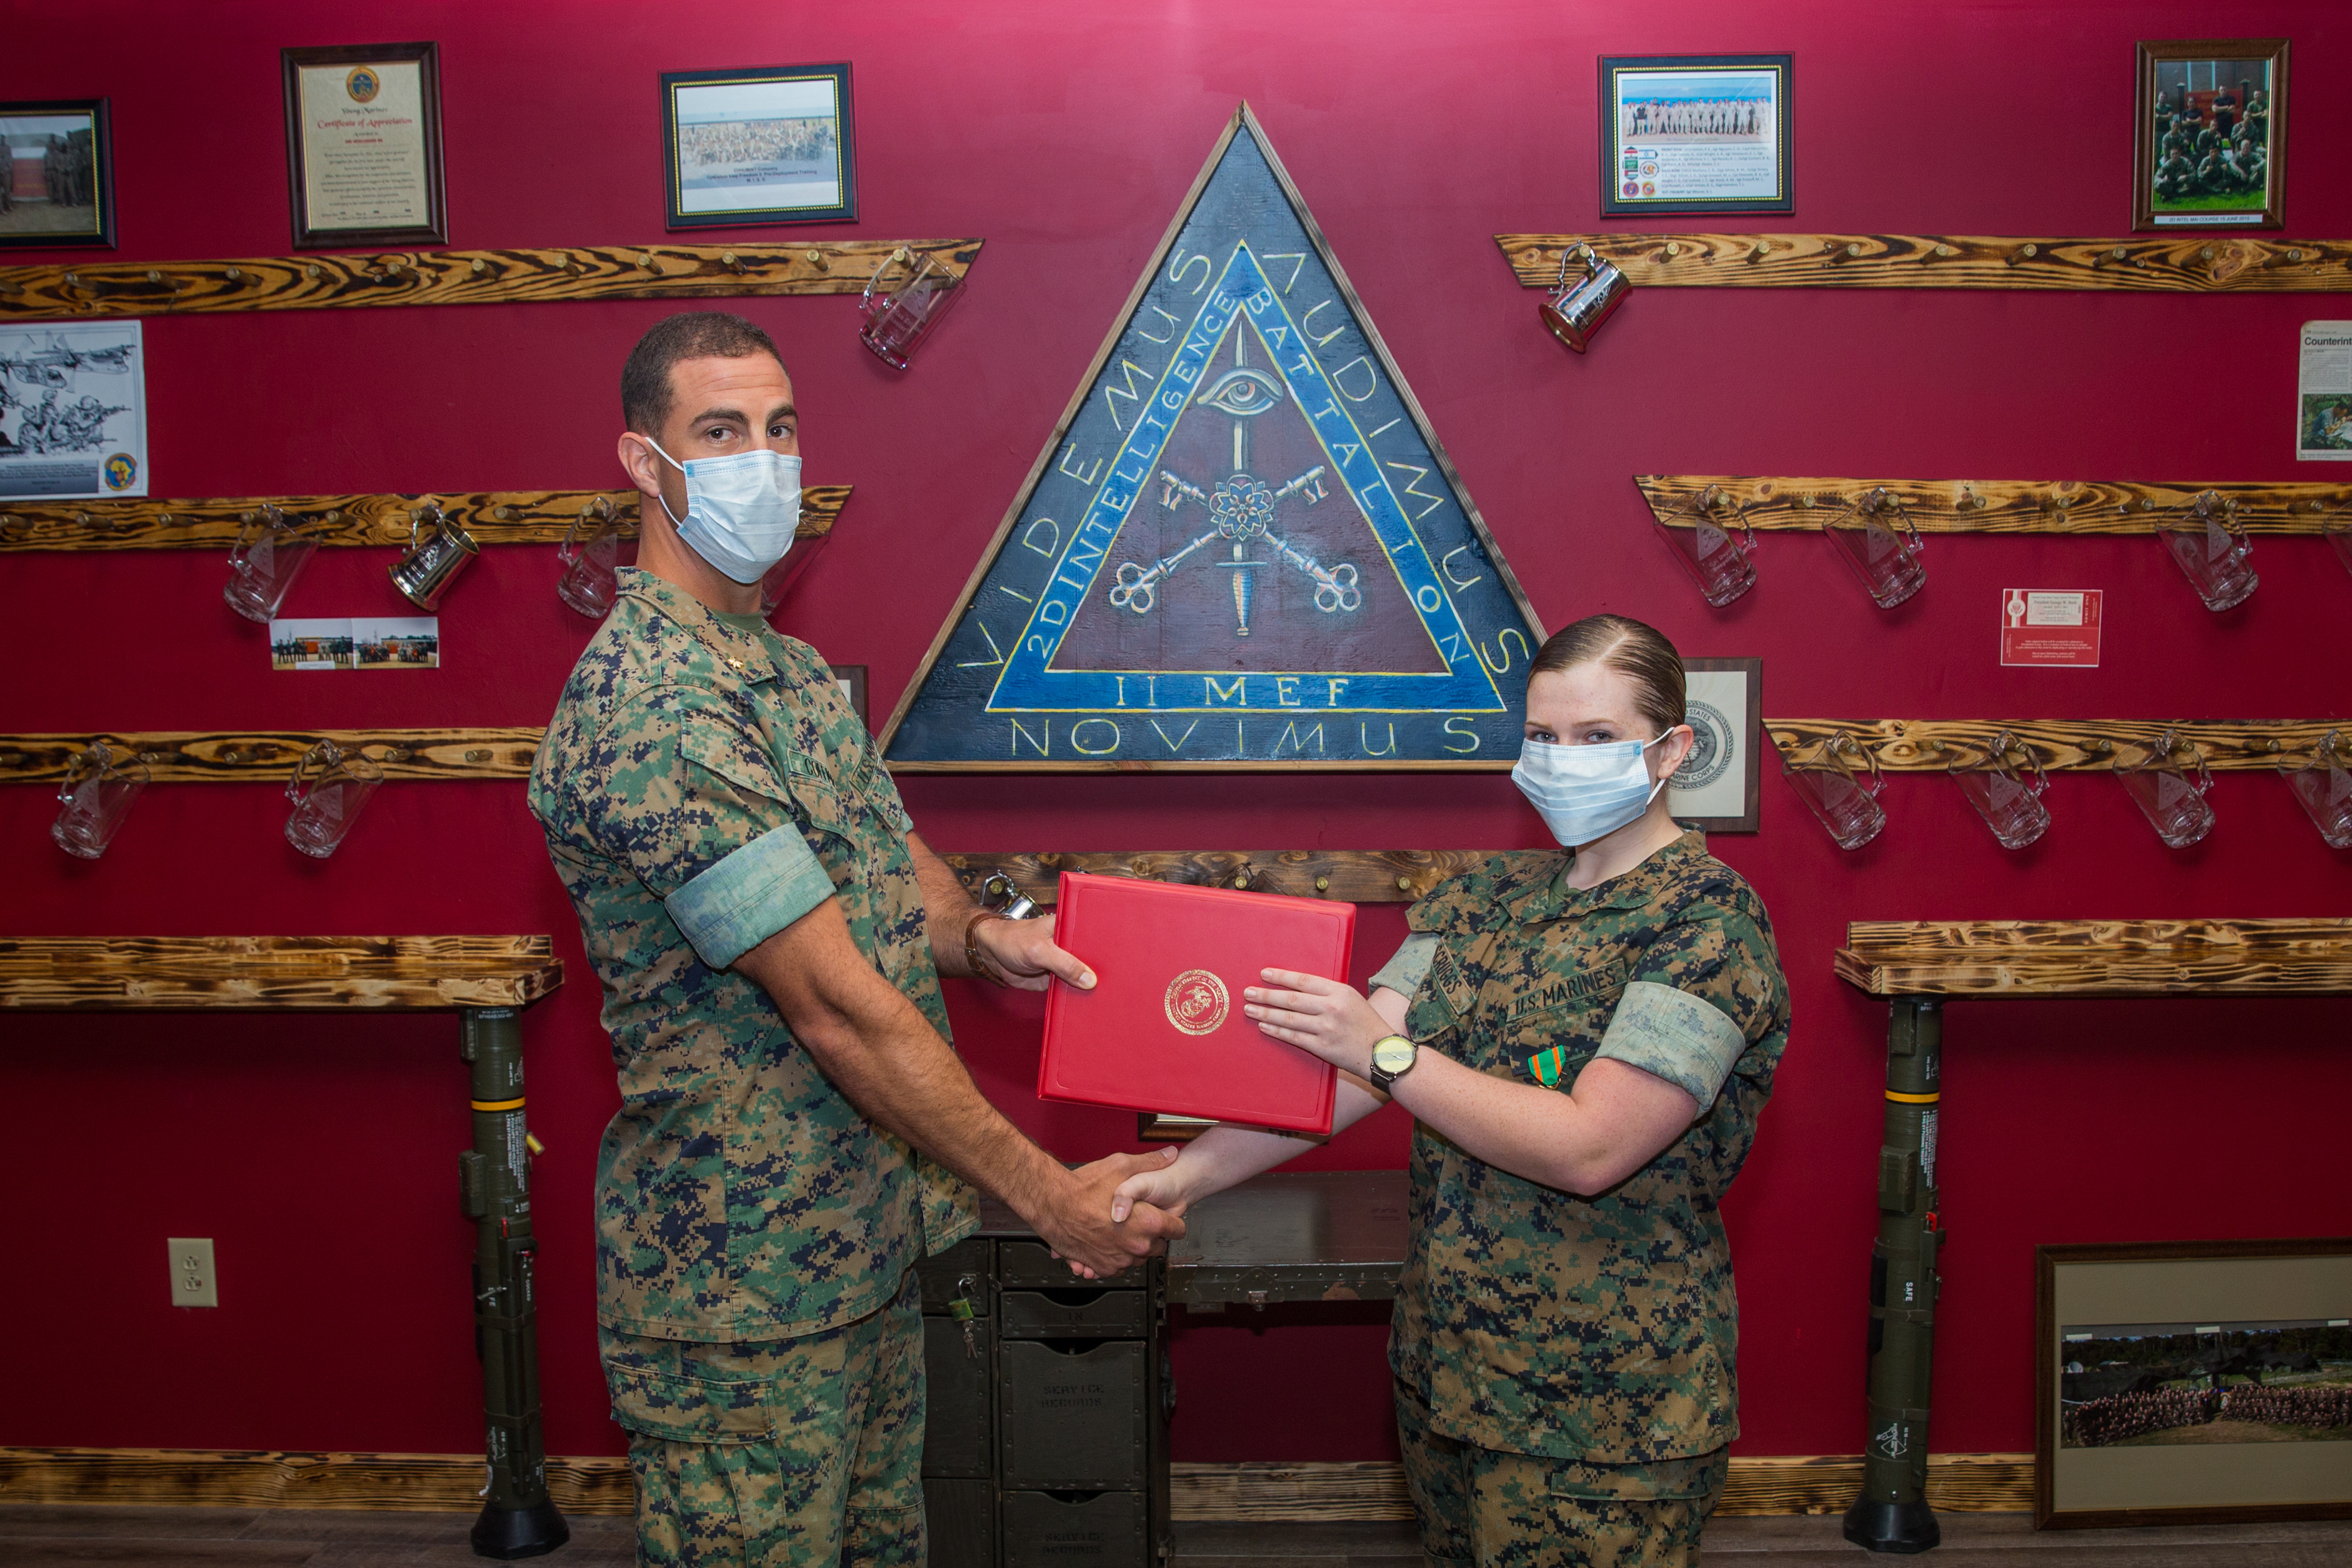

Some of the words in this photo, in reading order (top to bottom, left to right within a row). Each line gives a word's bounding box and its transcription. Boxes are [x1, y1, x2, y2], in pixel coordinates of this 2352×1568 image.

[317, 119, 356, 130] Certificate
[358, 118, 365, 129] of
[367, 117, 412, 128] Appreciation
[957, 249, 1211, 667] VIDEMUS
[1246, 286, 1470, 664] BATTALION
[1116, 675, 1157, 707] II
[1204, 677, 1349, 707] MEF
[1689, 708, 1711, 721] STATES
[1010, 717, 1481, 757] NOVIMUS
[1670, 772, 1690, 781] ARINE
[1691, 764, 1715, 781] CORPS
[1432, 944, 1462, 995] SCRUGGS
[1515, 995, 1540, 1016] U.S.
[1542, 967, 1616, 1007] MARINES
[1905, 1281, 1913, 1302] SAFE
[1044, 1384, 1105, 1394] SERVICE
[1041, 1398, 1102, 1408] RECORDS
